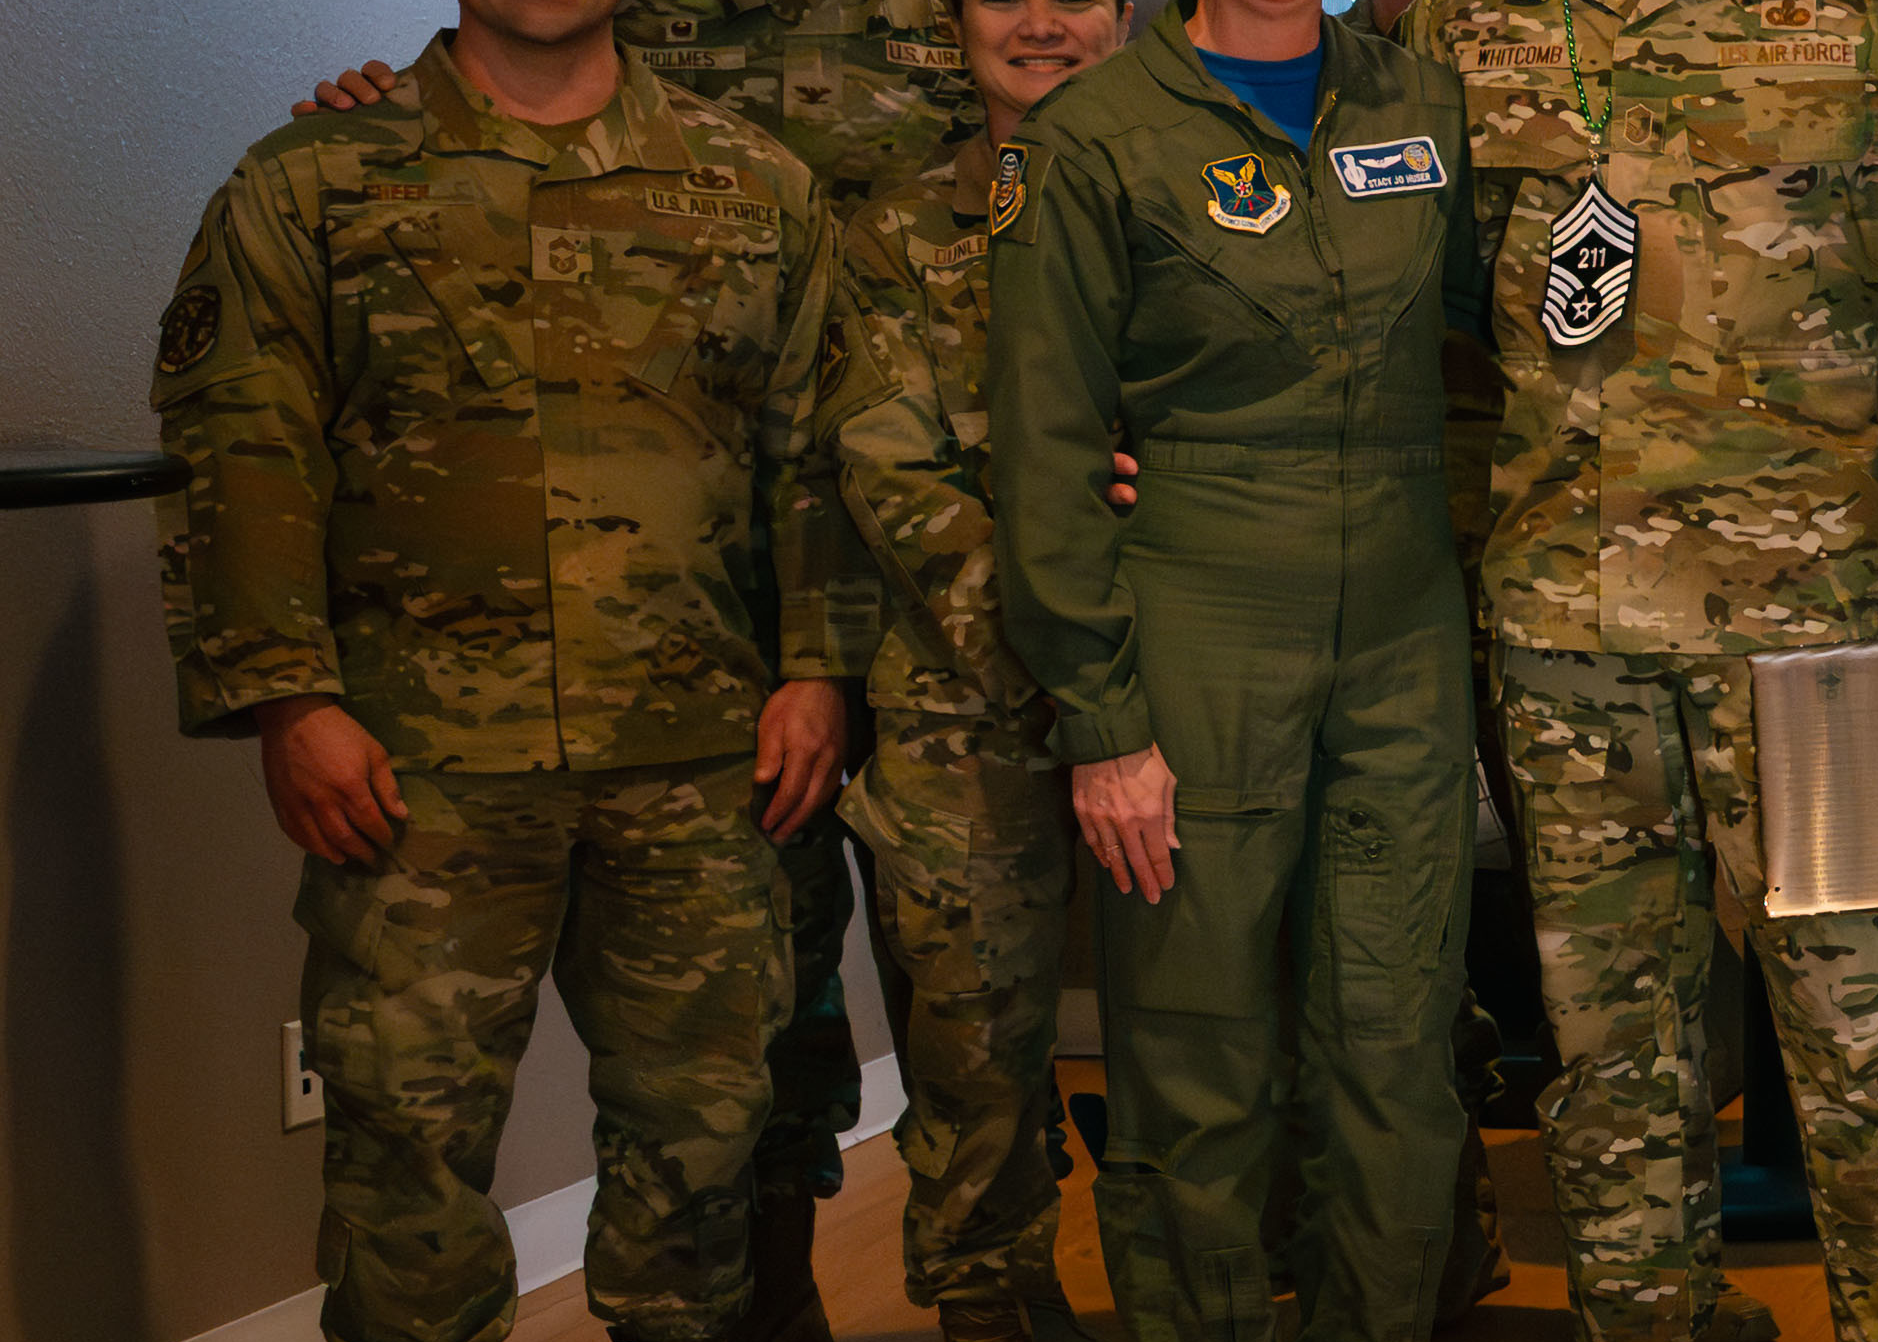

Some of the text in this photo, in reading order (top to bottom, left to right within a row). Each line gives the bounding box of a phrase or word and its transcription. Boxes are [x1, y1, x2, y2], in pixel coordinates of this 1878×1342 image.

[924, 49, 957, 66] AIR
[1477, 45, 1563, 68] WHITCOMB
[1756, 43, 1787, 64] AIR
[1792, 42, 1850, 64] FORCE
[1367, 177, 1393, 189] STACY
[1394, 174, 1405, 185] JO
[689, 197, 719, 218] AIR
[721, 199, 777, 226] FORCE
[1577, 247, 1606, 269] 211
